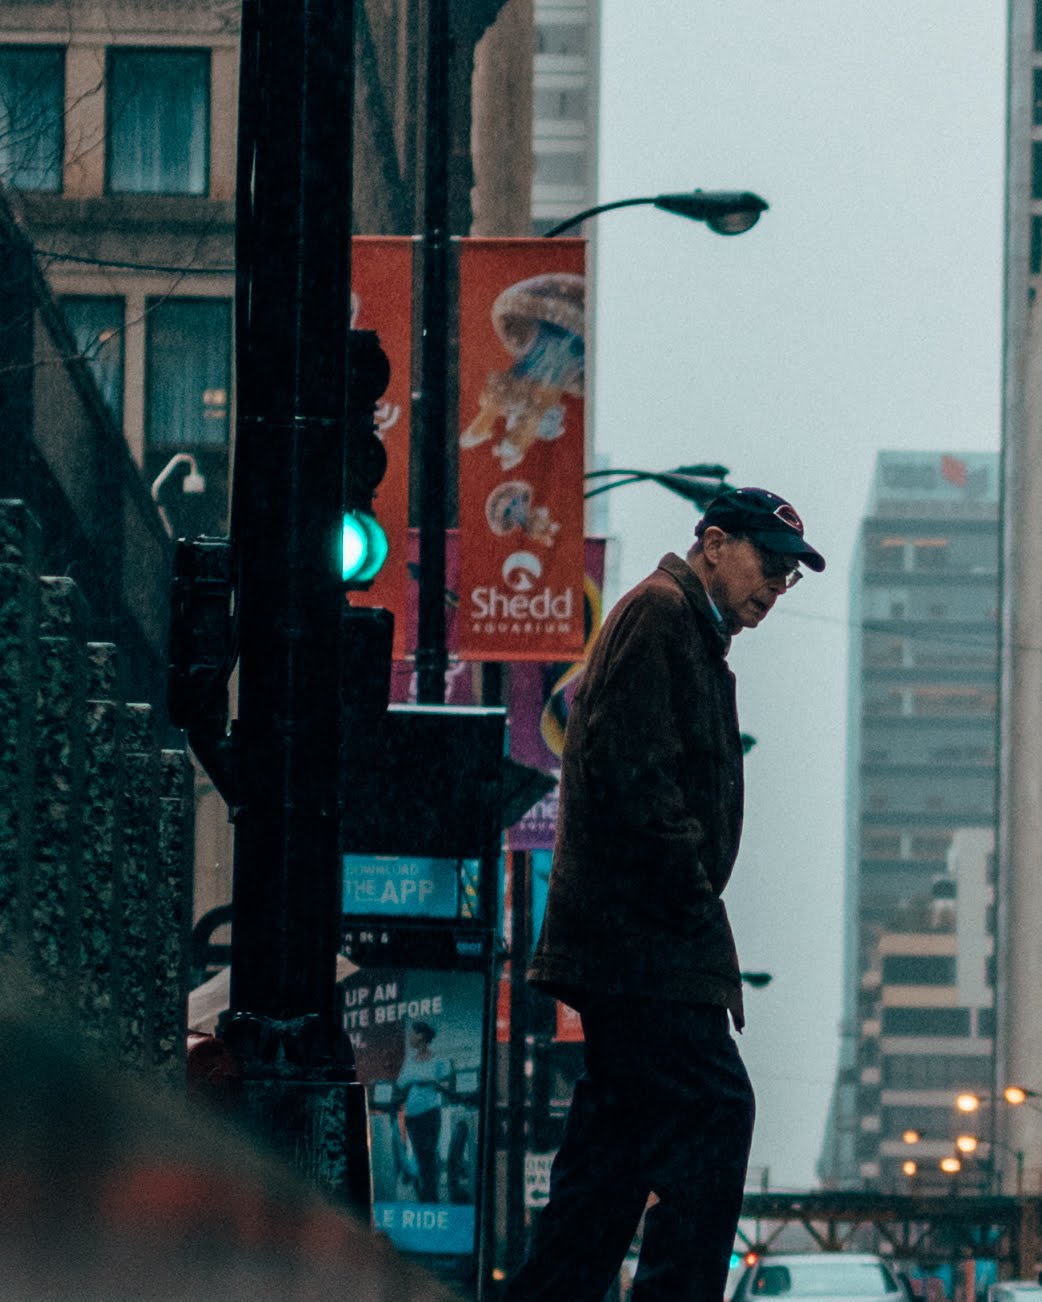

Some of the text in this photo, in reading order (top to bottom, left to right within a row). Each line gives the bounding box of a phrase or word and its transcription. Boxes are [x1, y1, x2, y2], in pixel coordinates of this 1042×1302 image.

[471, 586, 572, 619] Shedd
[471, 622, 571, 634] AQUARIUM
[343, 879, 434, 904] THE APP
[345, 983, 398, 1007] UP AN
[374, 995, 443, 1024] BEFORE
[402, 1210, 449, 1230] RIDE
